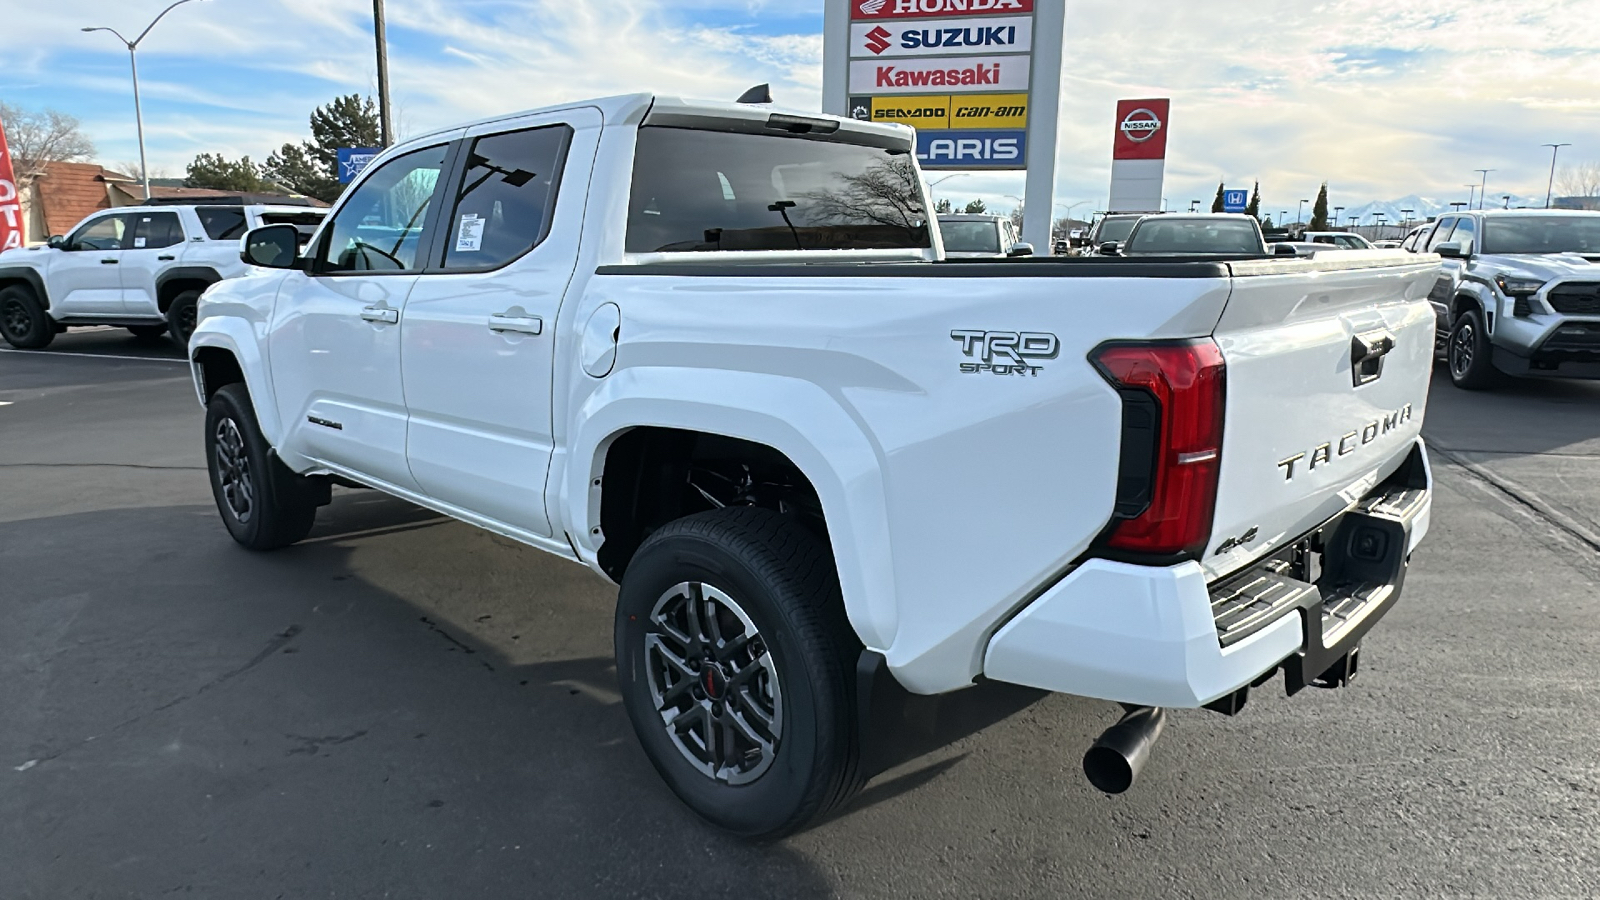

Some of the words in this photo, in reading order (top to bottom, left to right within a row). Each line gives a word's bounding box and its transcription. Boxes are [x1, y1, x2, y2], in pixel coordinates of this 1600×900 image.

[893, 0, 1022, 13] HONDA
[900, 26, 1015, 48] SUZUKI
[876, 63, 1000, 87] Kawasaki
[950, 329, 1060, 364] TRD
[960, 362, 1044, 377] SPORT
[1278, 402, 1412, 482] TACOMA
